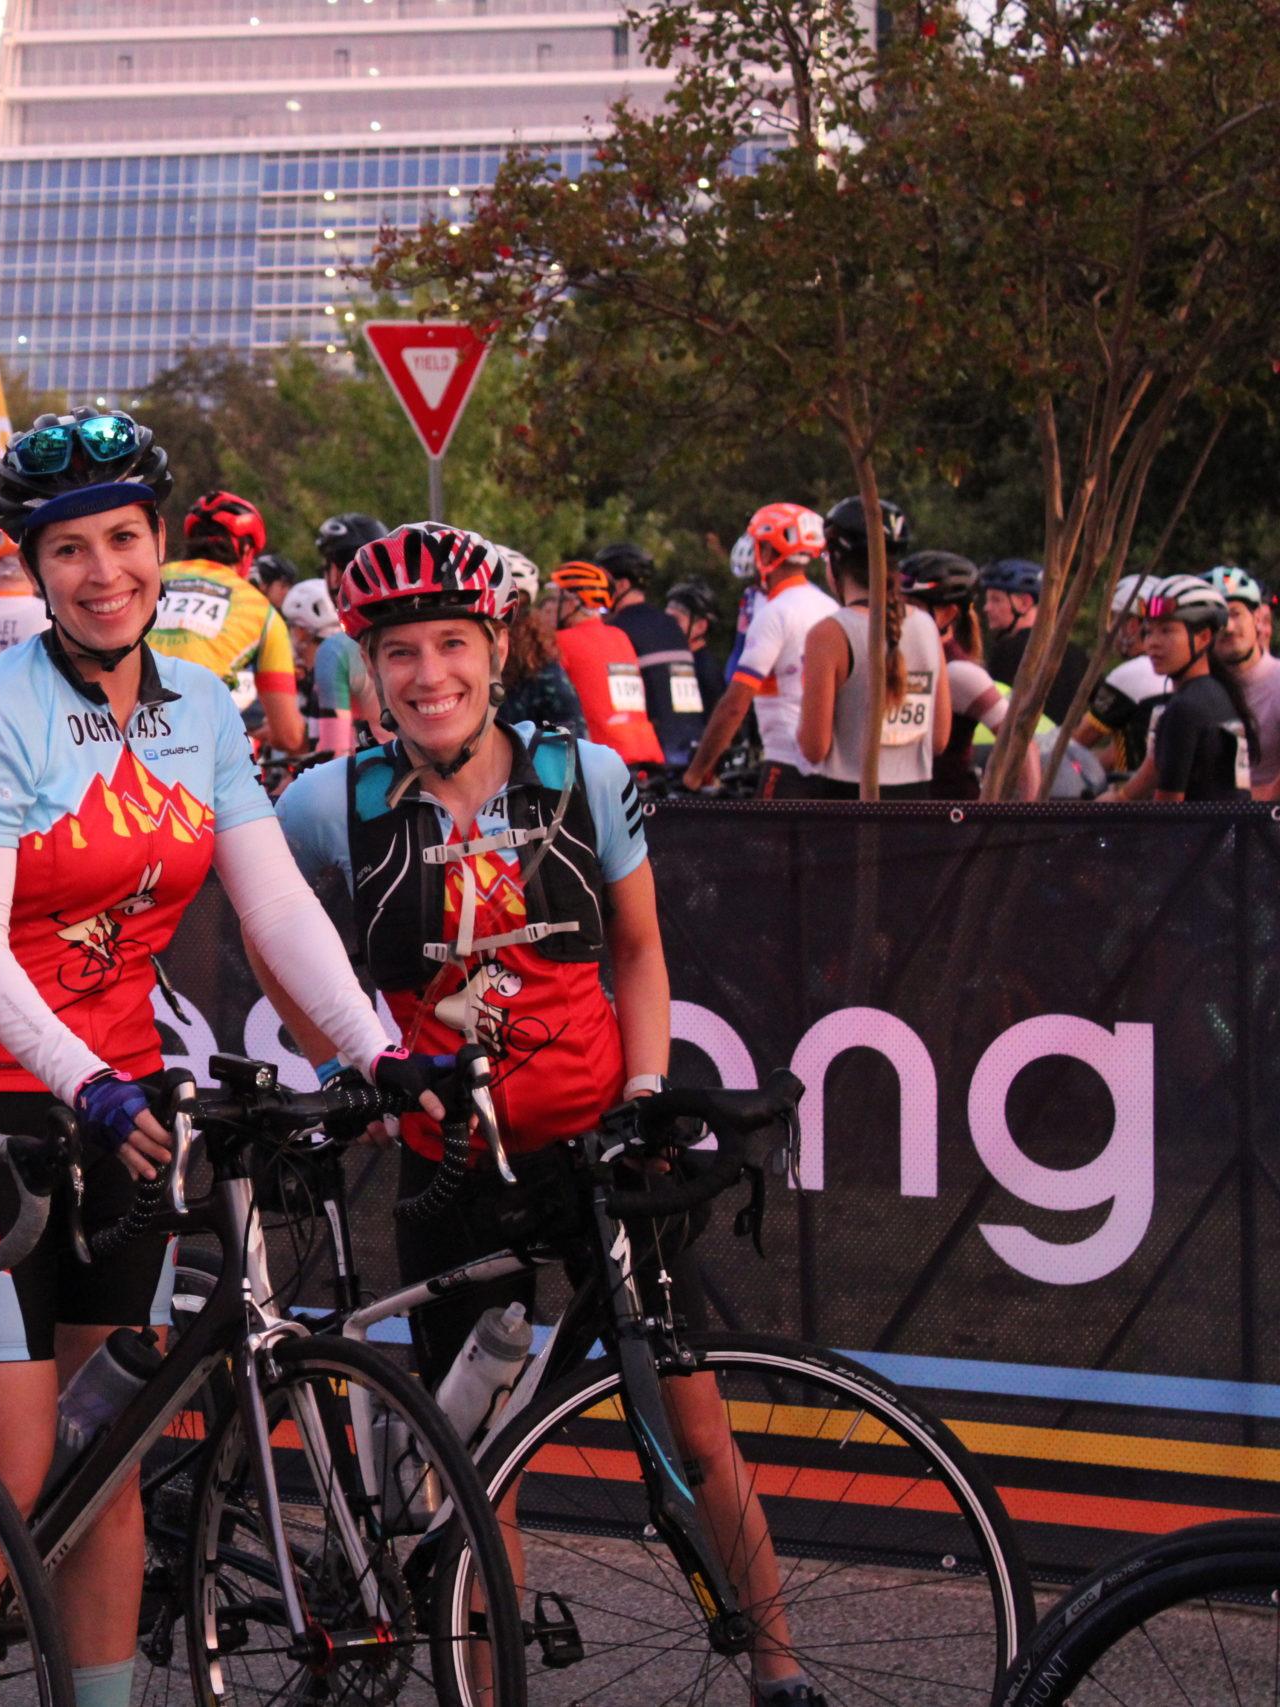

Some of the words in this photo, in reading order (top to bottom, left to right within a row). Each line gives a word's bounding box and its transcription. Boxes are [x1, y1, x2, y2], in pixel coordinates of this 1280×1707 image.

[413, 354, 450, 372] YIELD
[160, 597, 220, 621] 1274
[835, 1366, 898, 1403] ZAFFIRO
[1070, 1591, 1097, 1616] CDG
